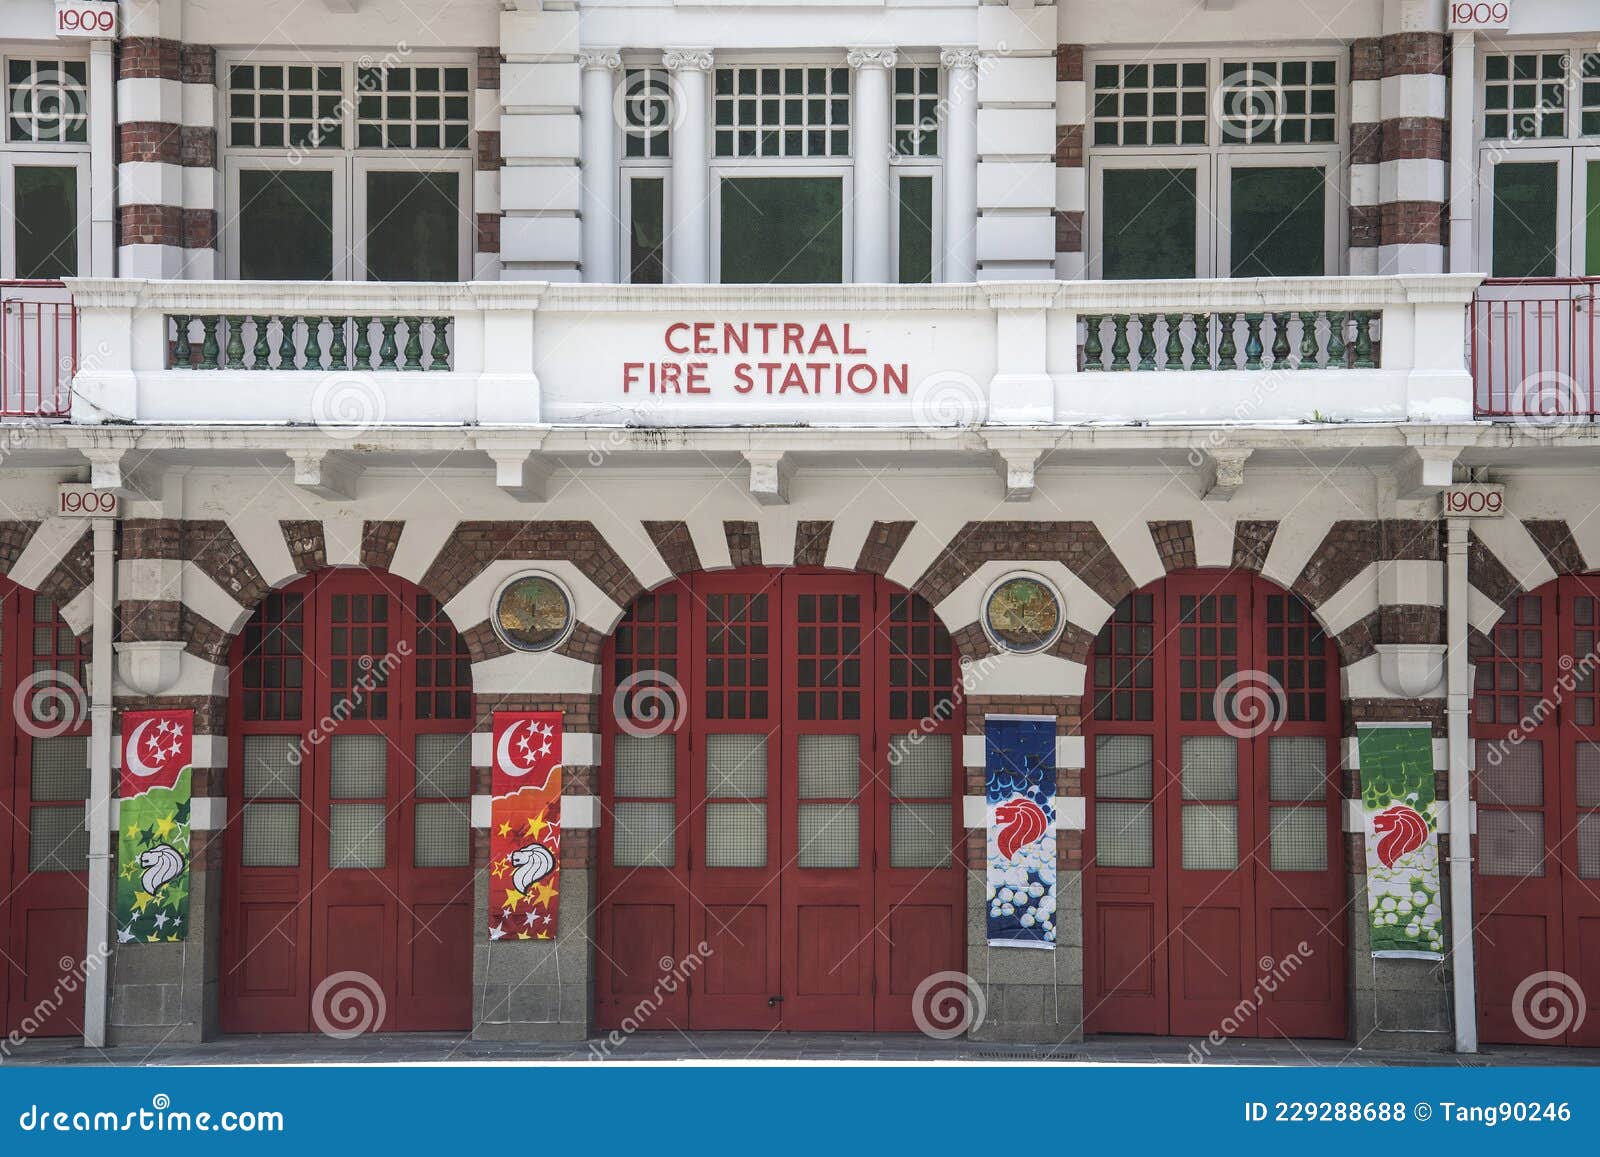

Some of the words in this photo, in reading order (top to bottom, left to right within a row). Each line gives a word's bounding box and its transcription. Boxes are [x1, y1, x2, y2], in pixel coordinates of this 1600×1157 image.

[58, 9, 114, 31] 1909
[1451, 2, 1508, 23] 1909
[664, 322, 867, 354] CENTRAL
[623, 362, 711, 394] FIRE
[733, 362, 908, 394] STATION
[61, 492, 116, 512] 1909
[1446, 491, 1503, 512] 1909
